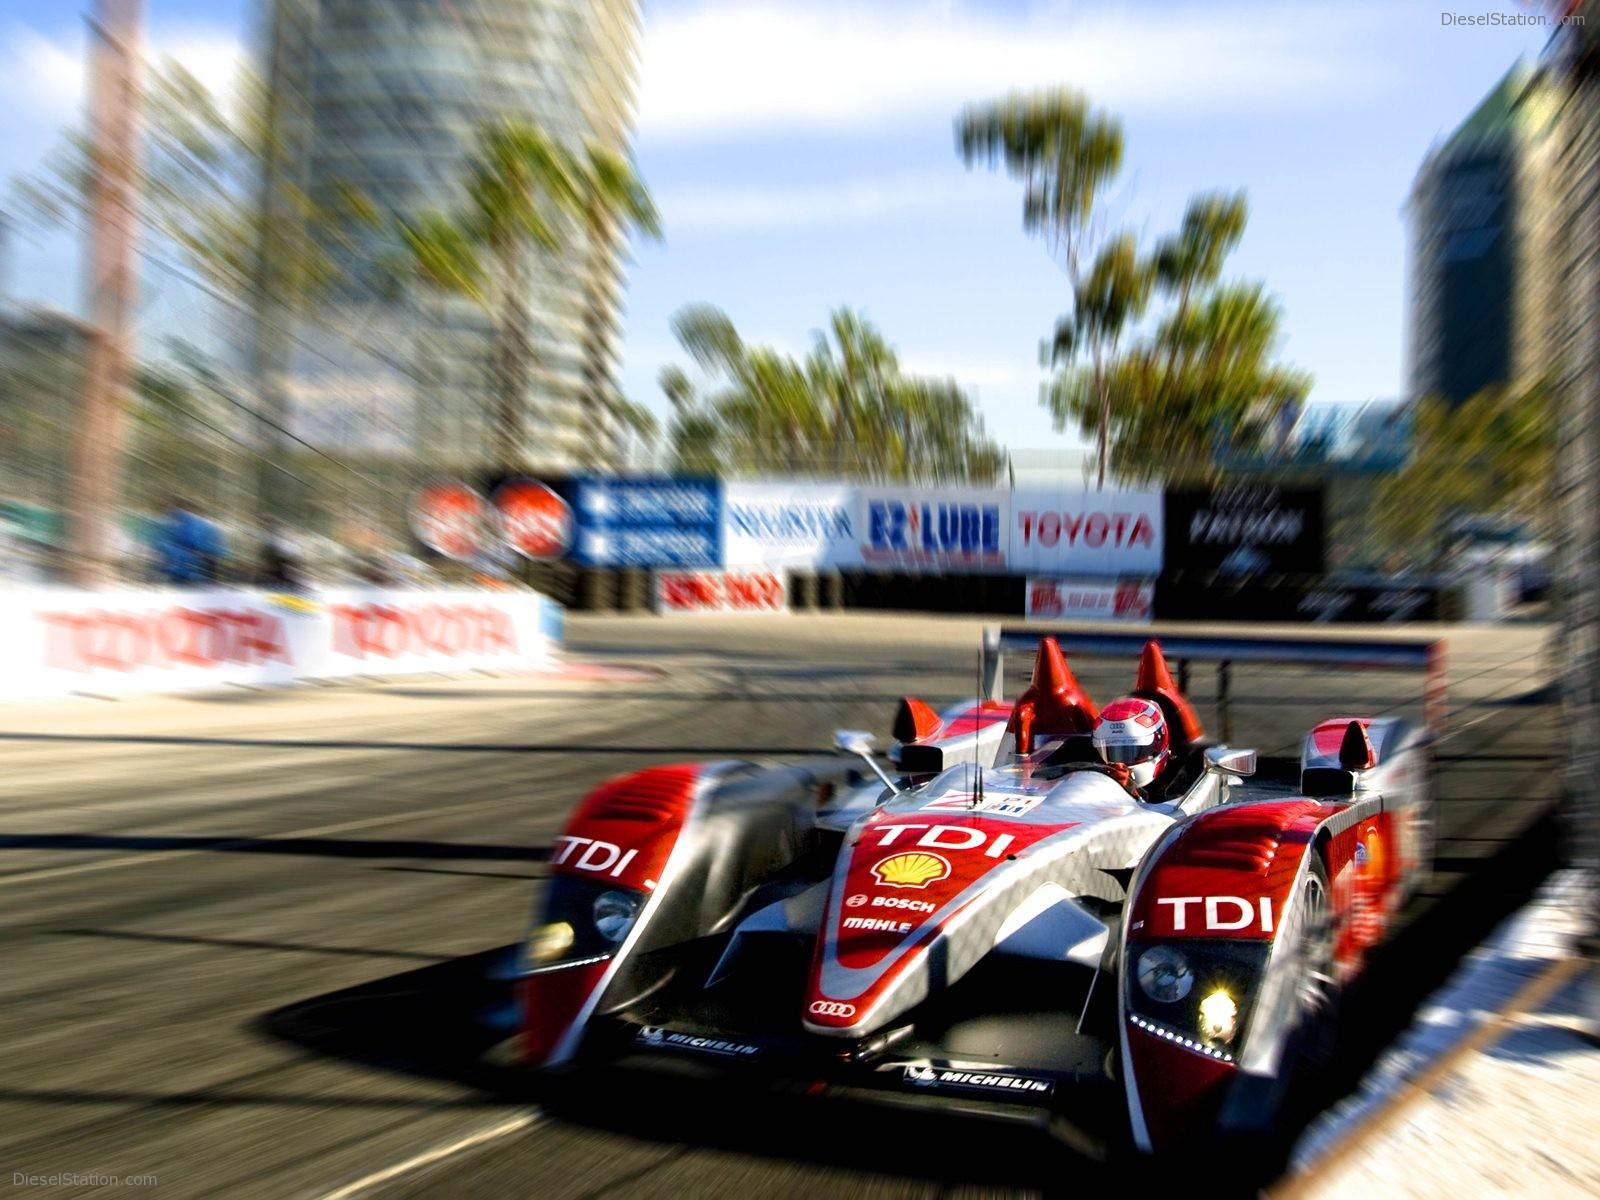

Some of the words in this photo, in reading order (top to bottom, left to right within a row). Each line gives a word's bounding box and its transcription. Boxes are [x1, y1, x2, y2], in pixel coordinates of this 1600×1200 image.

[1017, 510, 1156, 549] TOYOTA
[873, 824, 1015, 858] TDI
[553, 835, 639, 878] TDI
[871, 896, 936, 913] BOSCH
[1157, 896, 1274, 932] TDI
[843, 917, 912, 934] MAHLE
[667, 1033, 758, 1054] MICHELIN
[940, 1071, 1049, 1091] MICHELIN
